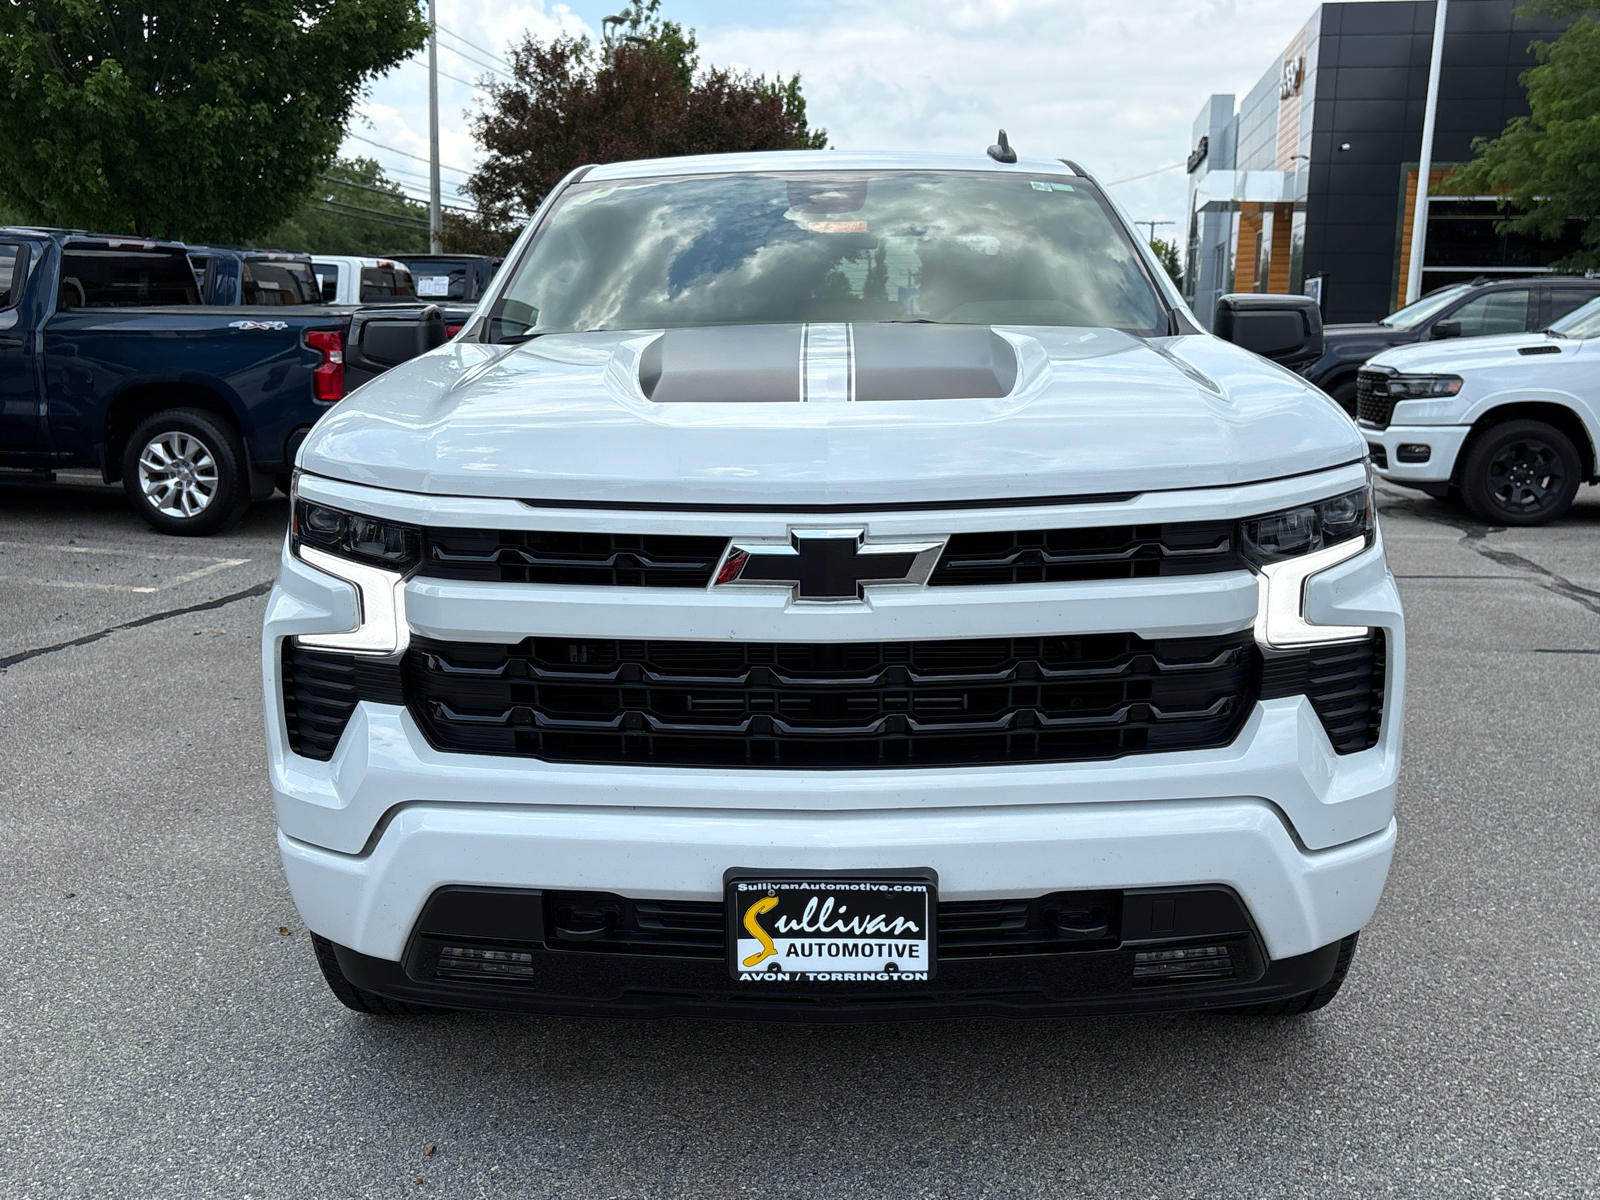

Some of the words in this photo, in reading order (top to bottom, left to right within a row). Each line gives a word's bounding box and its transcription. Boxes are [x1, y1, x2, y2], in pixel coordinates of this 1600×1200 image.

[737, 882, 927, 893] SullivanAutomotive.com
[742, 896, 919, 967] Sullivan
[785, 942, 920, 958] AUTOMOTIVE
[739, 972, 790, 981] AVON
[805, 972, 928, 981] TORRINGTON
